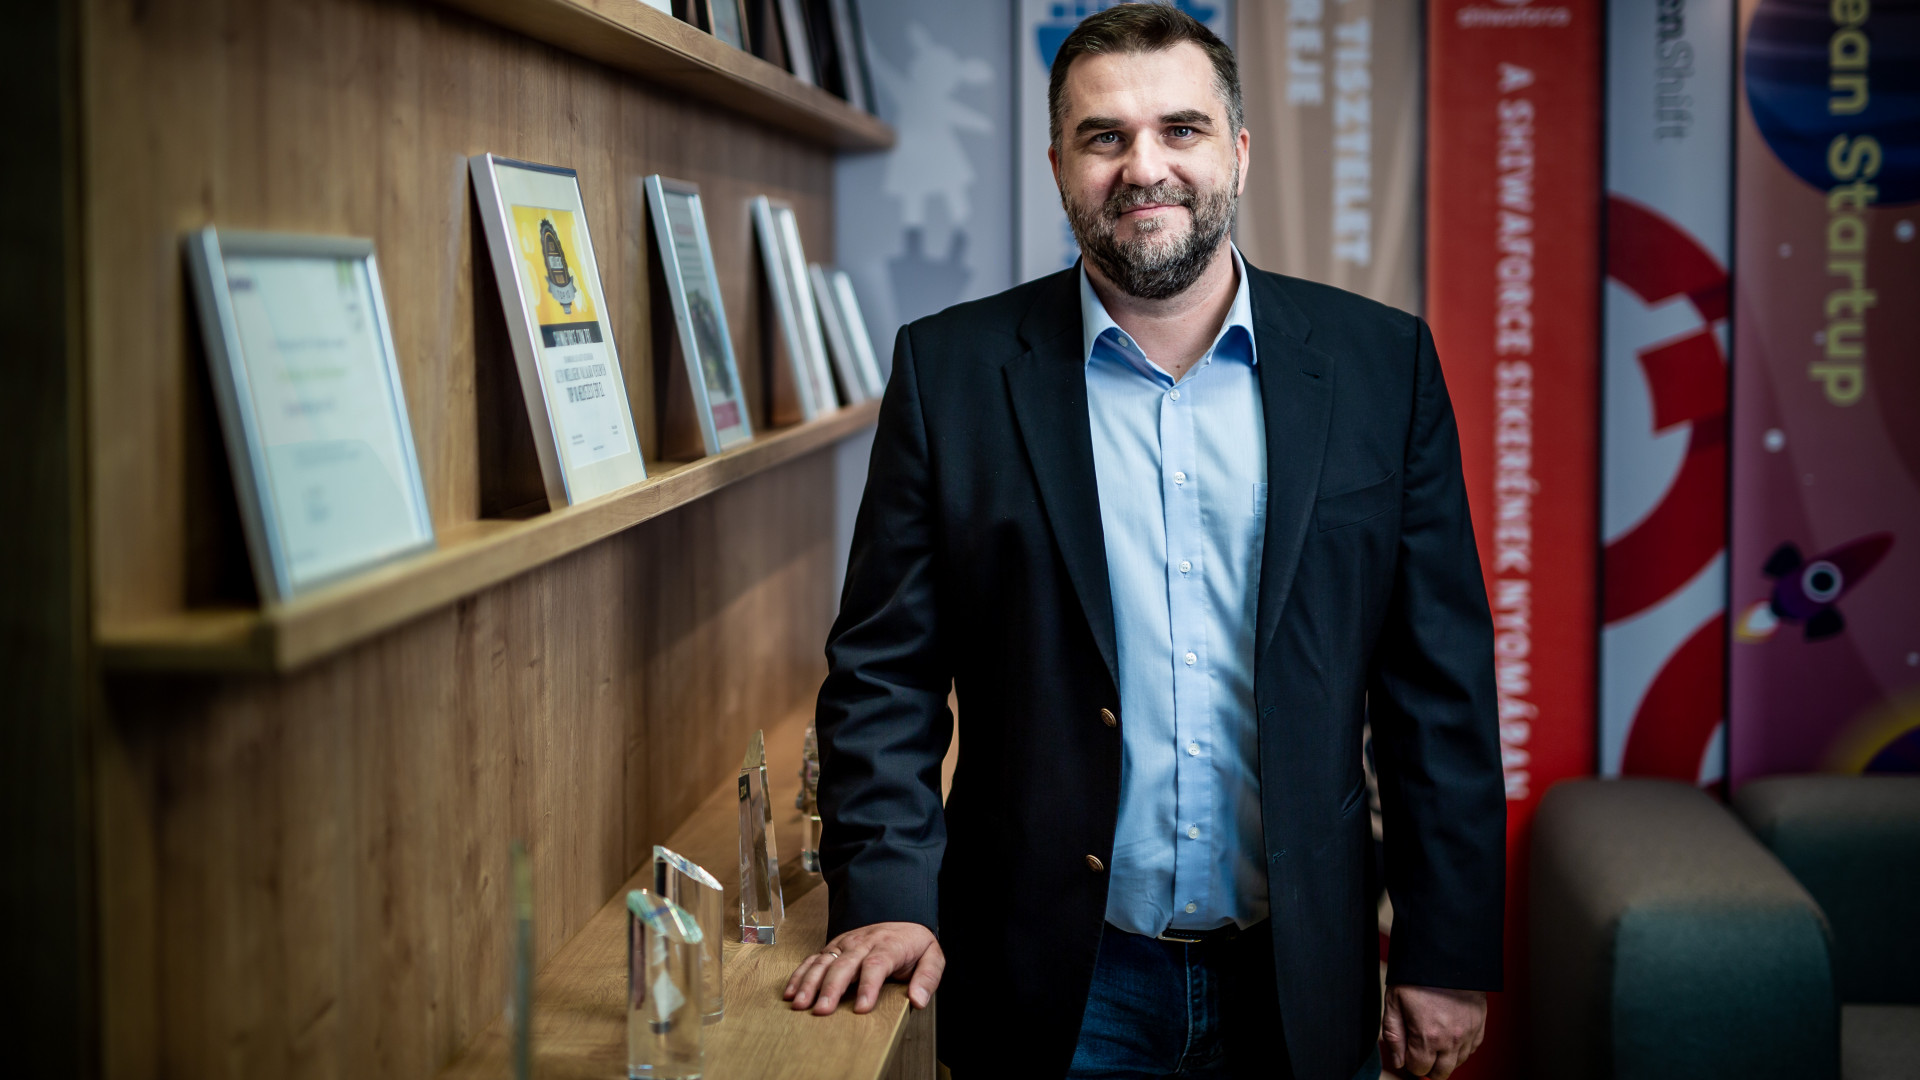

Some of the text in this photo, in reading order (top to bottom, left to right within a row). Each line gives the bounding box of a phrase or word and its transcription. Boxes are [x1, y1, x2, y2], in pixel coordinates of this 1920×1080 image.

[1332, 19, 1373, 267] TISZTELET
[1811, 0, 1882, 406] ean Startup
[1495, 63, 1540, 800] A SHIWAFORCE SIKERÉNEK NYOMÁBAN
